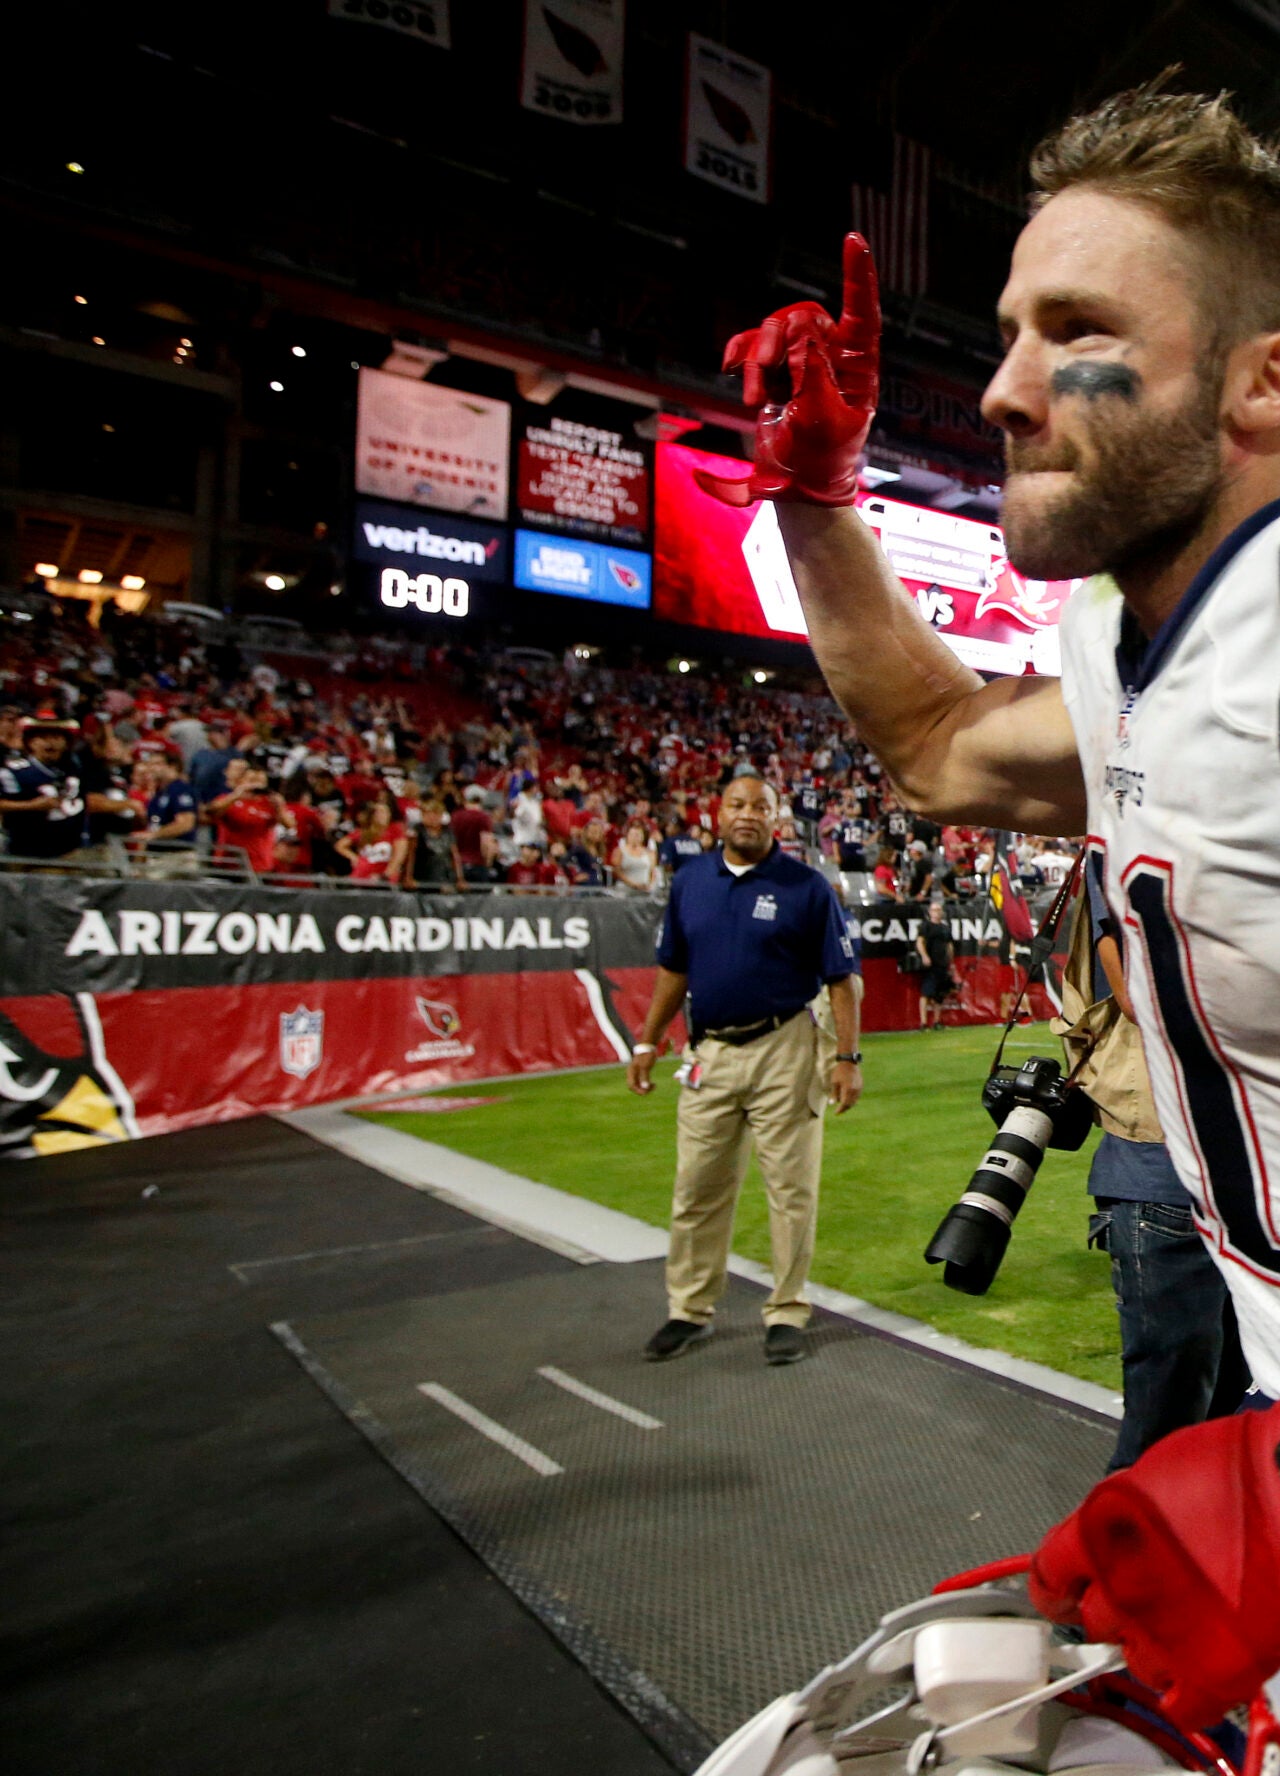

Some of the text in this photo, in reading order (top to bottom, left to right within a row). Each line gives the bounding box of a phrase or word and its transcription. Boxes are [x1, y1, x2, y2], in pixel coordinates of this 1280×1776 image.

[367, 437, 499, 474] UNIVERSITY
[362, 521, 486, 566] verizon
[380, 567, 470, 617] 0:00
[916, 589, 955, 627] VS
[65, 909, 592, 957] ARIZONA CARDINALS
